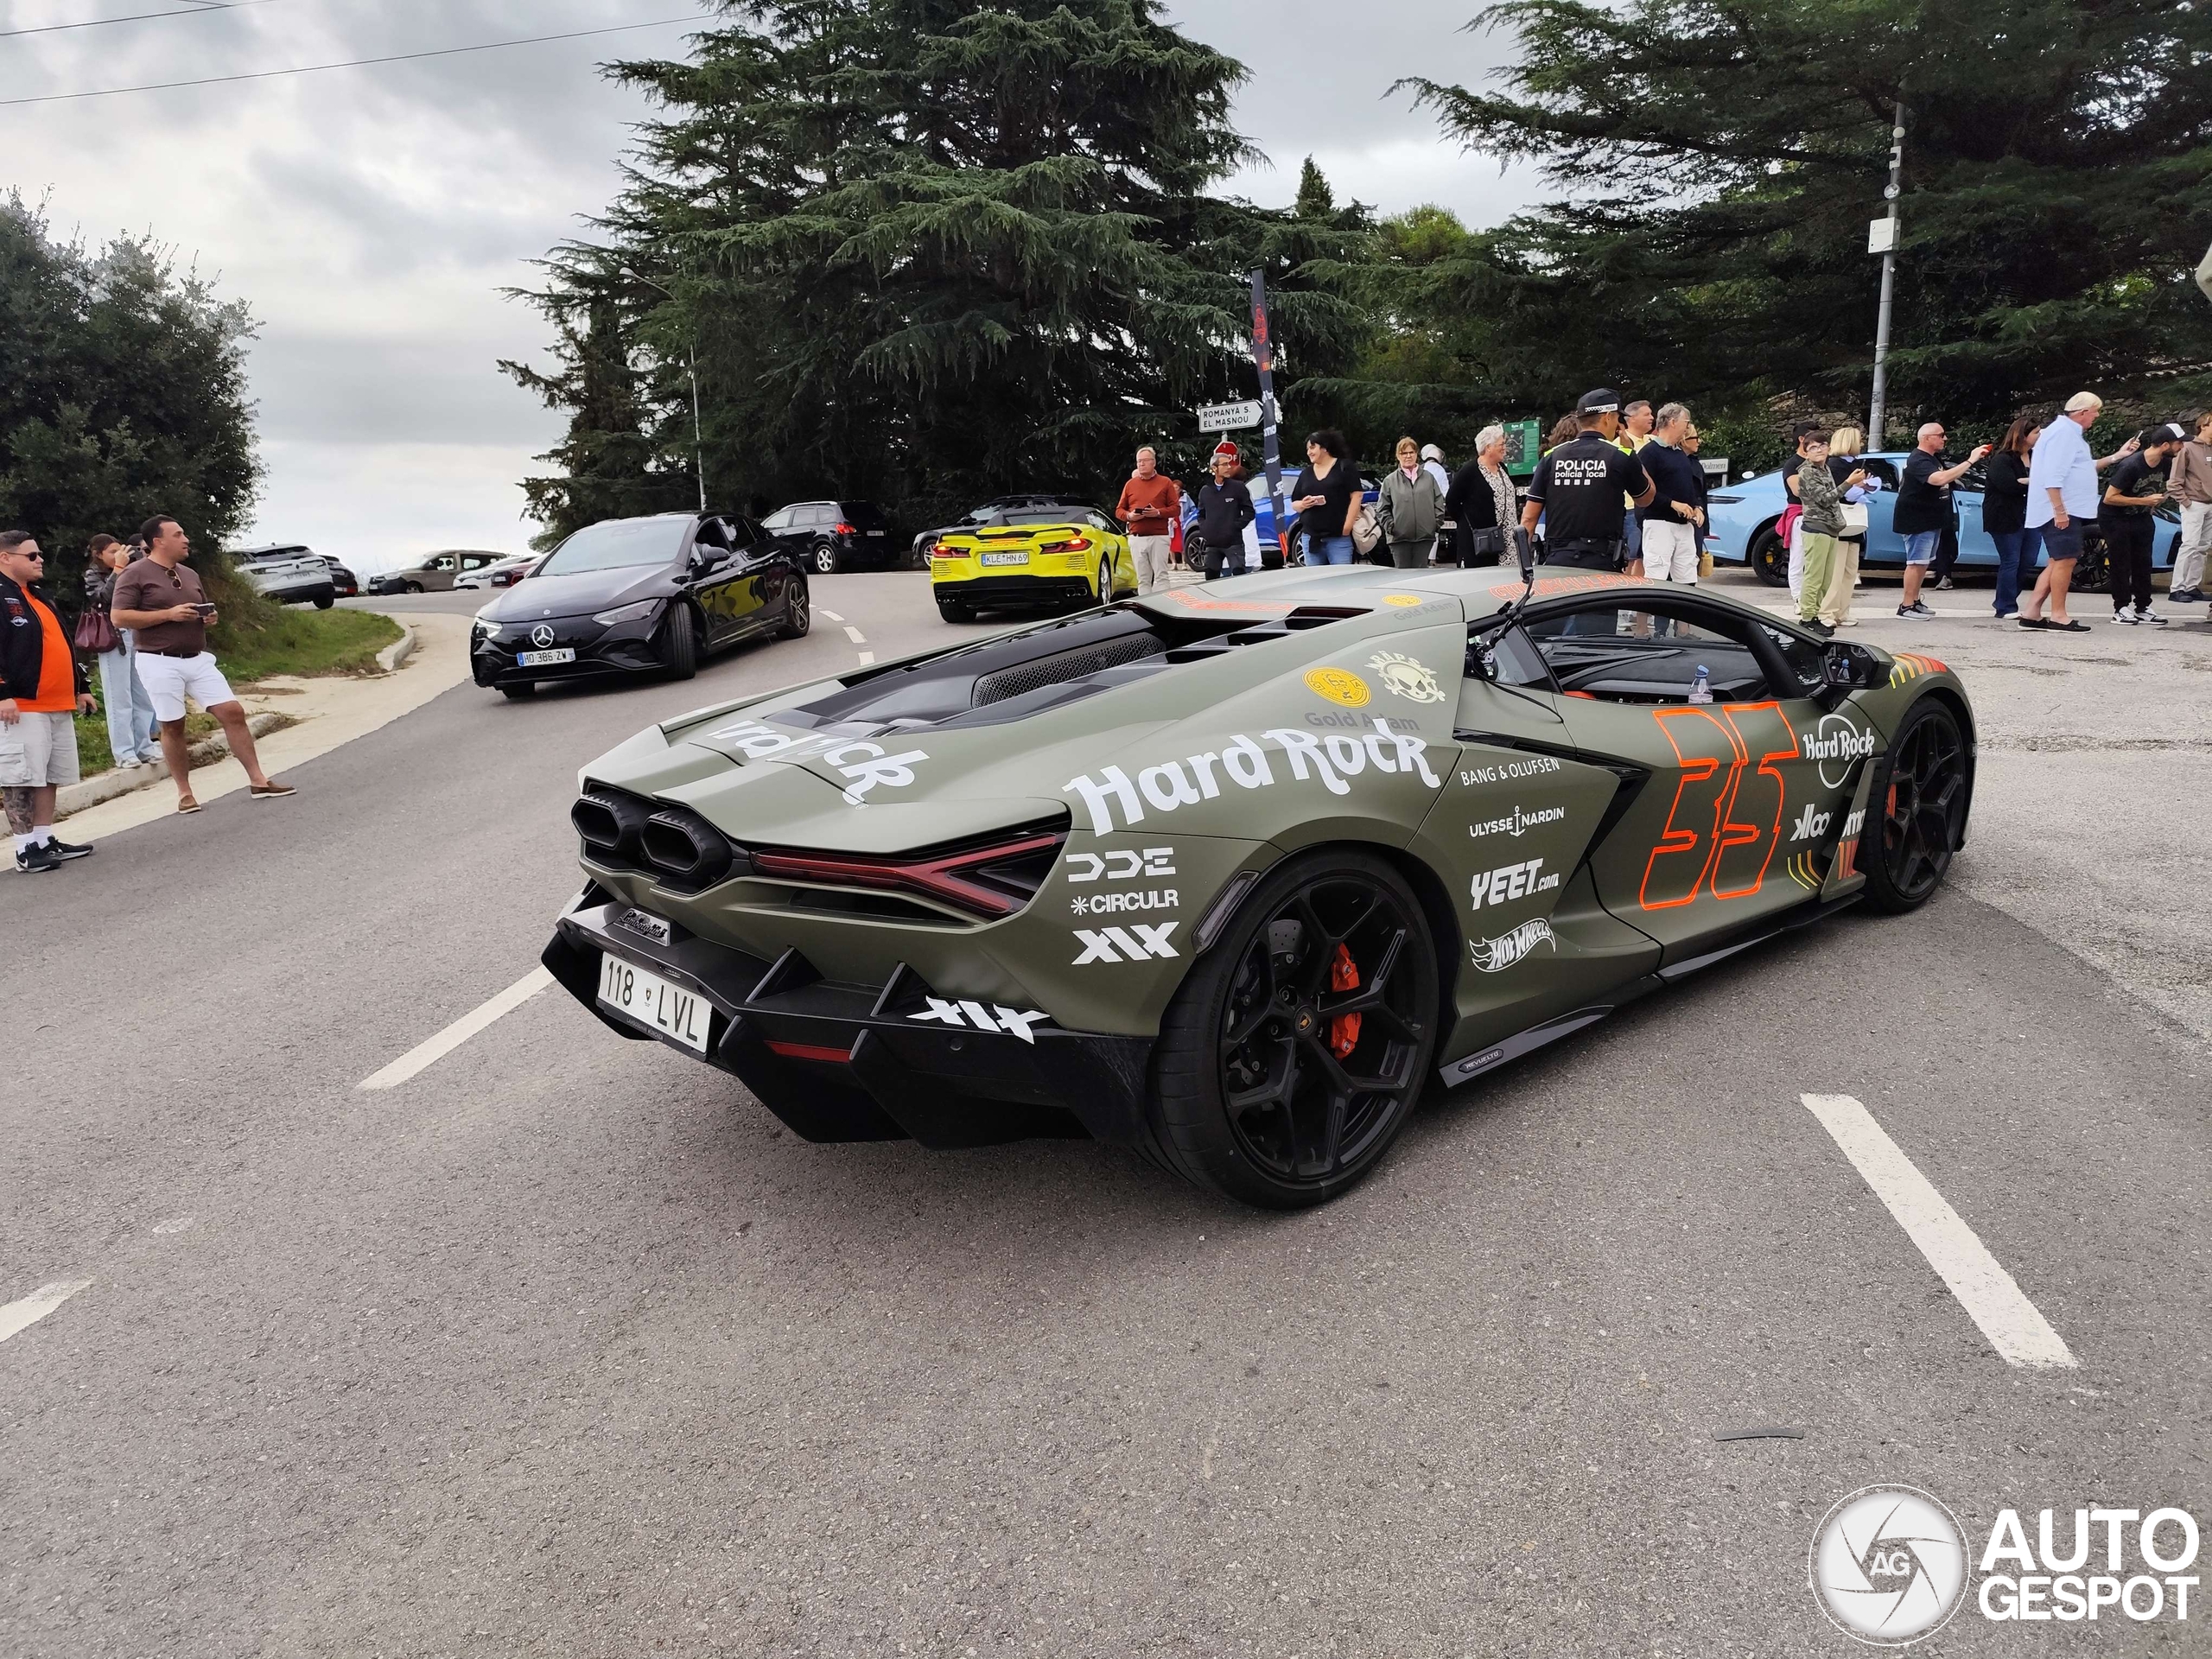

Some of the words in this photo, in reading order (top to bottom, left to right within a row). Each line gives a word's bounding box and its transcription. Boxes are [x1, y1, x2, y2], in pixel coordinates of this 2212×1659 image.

[1203, 405, 1240, 418] ROMANYÀ
[1215, 416, 1249, 427] MASNOU
[1554, 469, 1583, 479] policia
[1555, 460, 1607, 471] POLICIA
[986, 554, 1001, 563] KLE
[1006, 554, 1017, 563] HN
[1018, 553, 1028, 562] 69
[1394, 608, 1423, 621] Gold
[1422, 602, 1456, 614] Adam
[1304, 711, 1358, 728] Gold
[1359, 713, 1421, 730] Aam
[1802, 731, 1839, 760] Hard
[1839, 727, 1875, 761] Rock
[1062, 734, 1274, 837] Hard
[1261, 718, 1440, 795] Rock
[1460, 766, 1497, 786] BANG
[1498, 765, 1509, 780] &
[1509, 758, 1560, 778] OLUFSEN
[1469, 817, 1514, 838] ULYSSE
[1521, 806, 1565, 827] NARDIN
[1470, 857, 1560, 911] YEET.com
[1071, 921, 1180, 965] XIX
[607, 960, 634, 1007] 118
[657, 984, 698, 1043] LVL
[906, 995, 1051, 1045] XIX
[1464, 1050, 1499, 1070] REVUELTO
